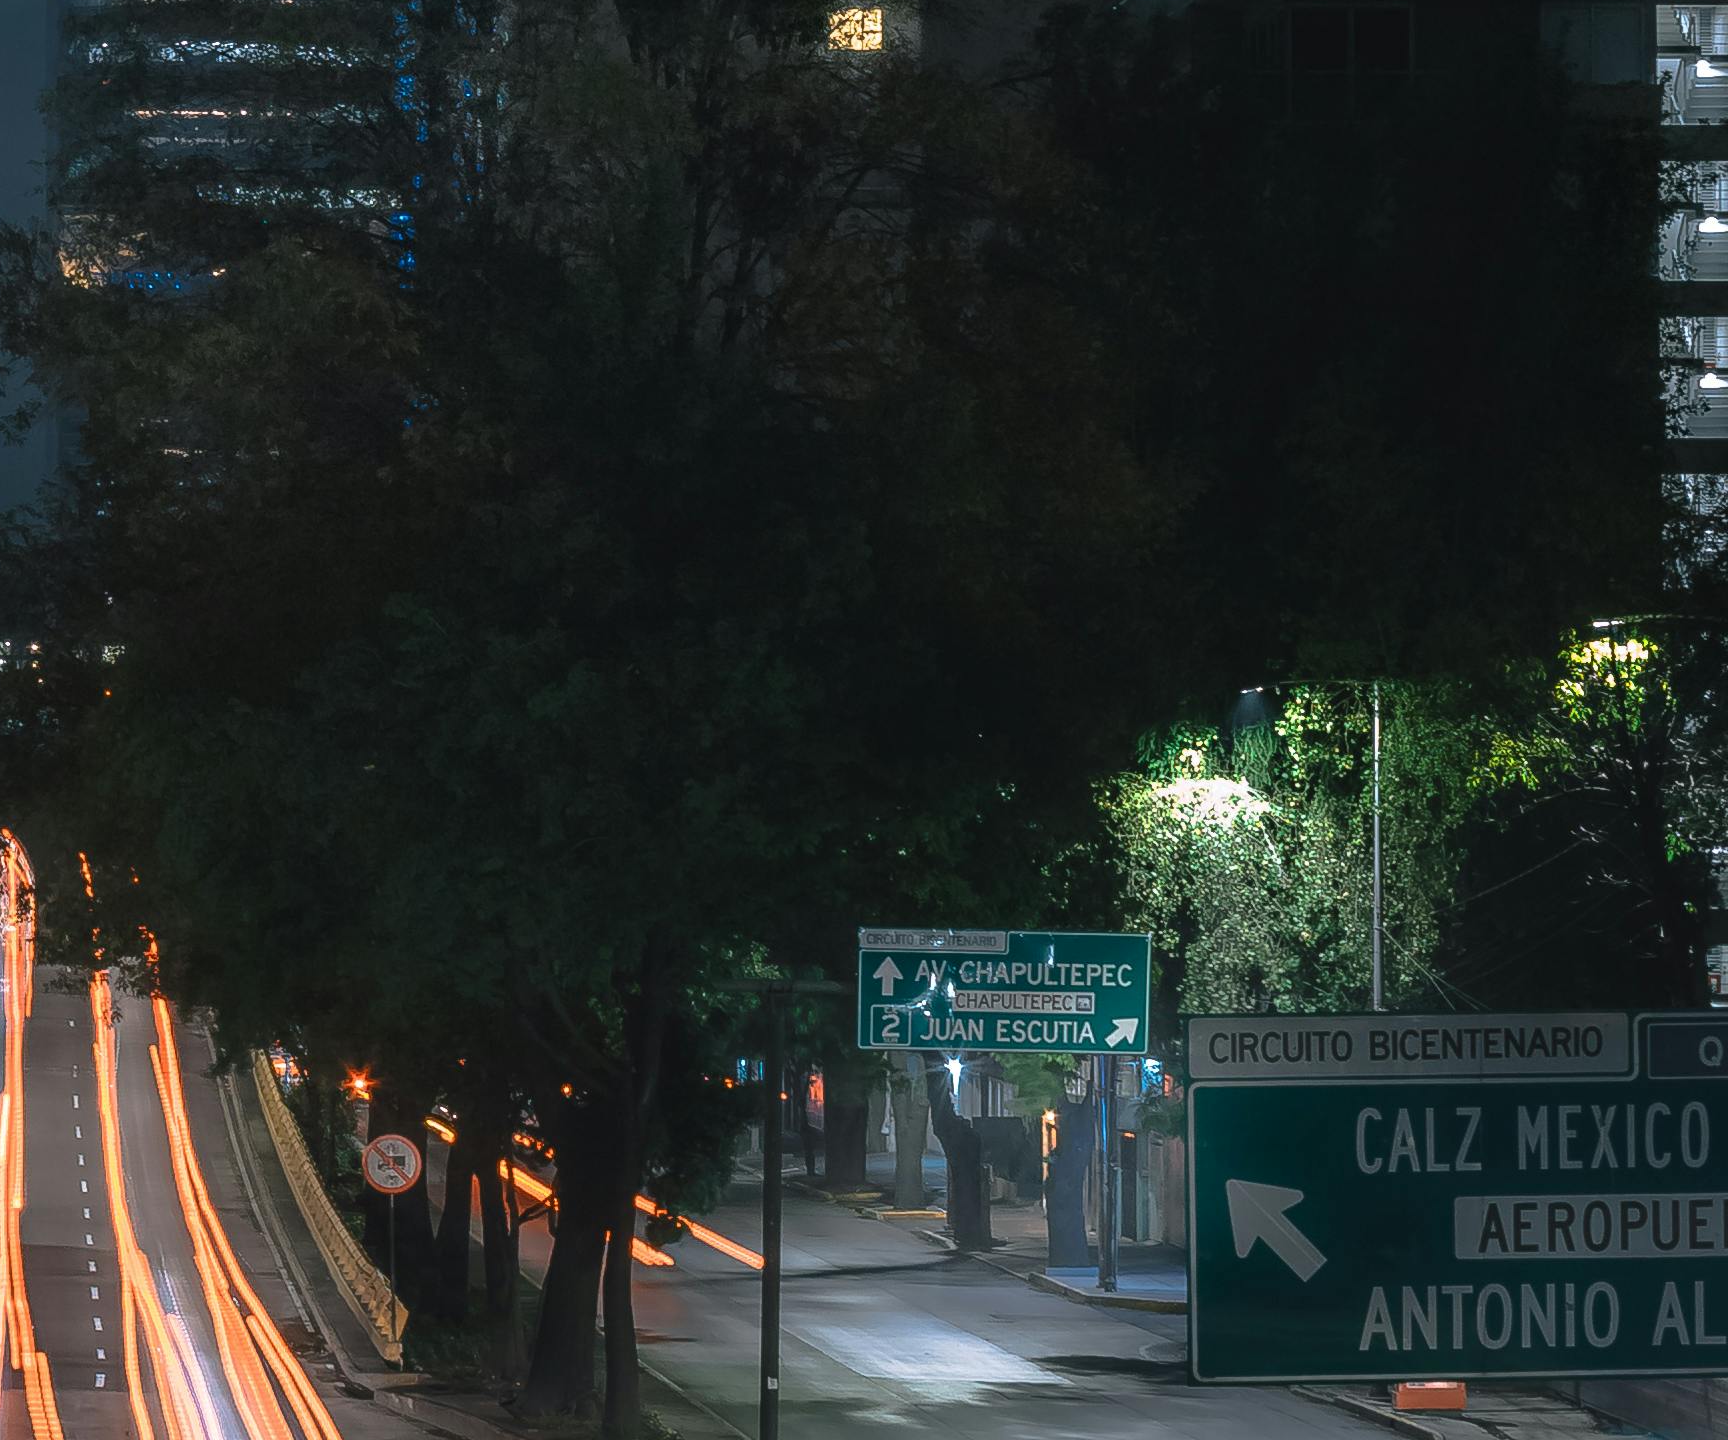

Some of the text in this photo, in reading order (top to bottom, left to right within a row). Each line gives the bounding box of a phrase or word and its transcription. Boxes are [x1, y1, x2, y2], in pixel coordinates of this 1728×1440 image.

[866, 933, 914, 945] CIRCUITO
[915, 959, 1133, 987] AV CHAPULTEPEC
[955, 992, 1073, 1011] CHAPULTEPEC
[881, 1013, 900, 1038] 2
[919, 1017, 1096, 1045] JUAN ESCUTIA
[1208, 1025, 1604, 1065] CIRCUITO BICENTENARIO
[1356, 1100, 1711, 1175] CALZ MEXICO
[1477, 1197, 1728, 1255] AEROPUE
[1358, 1280, 1620, 1353] ANTONIO
